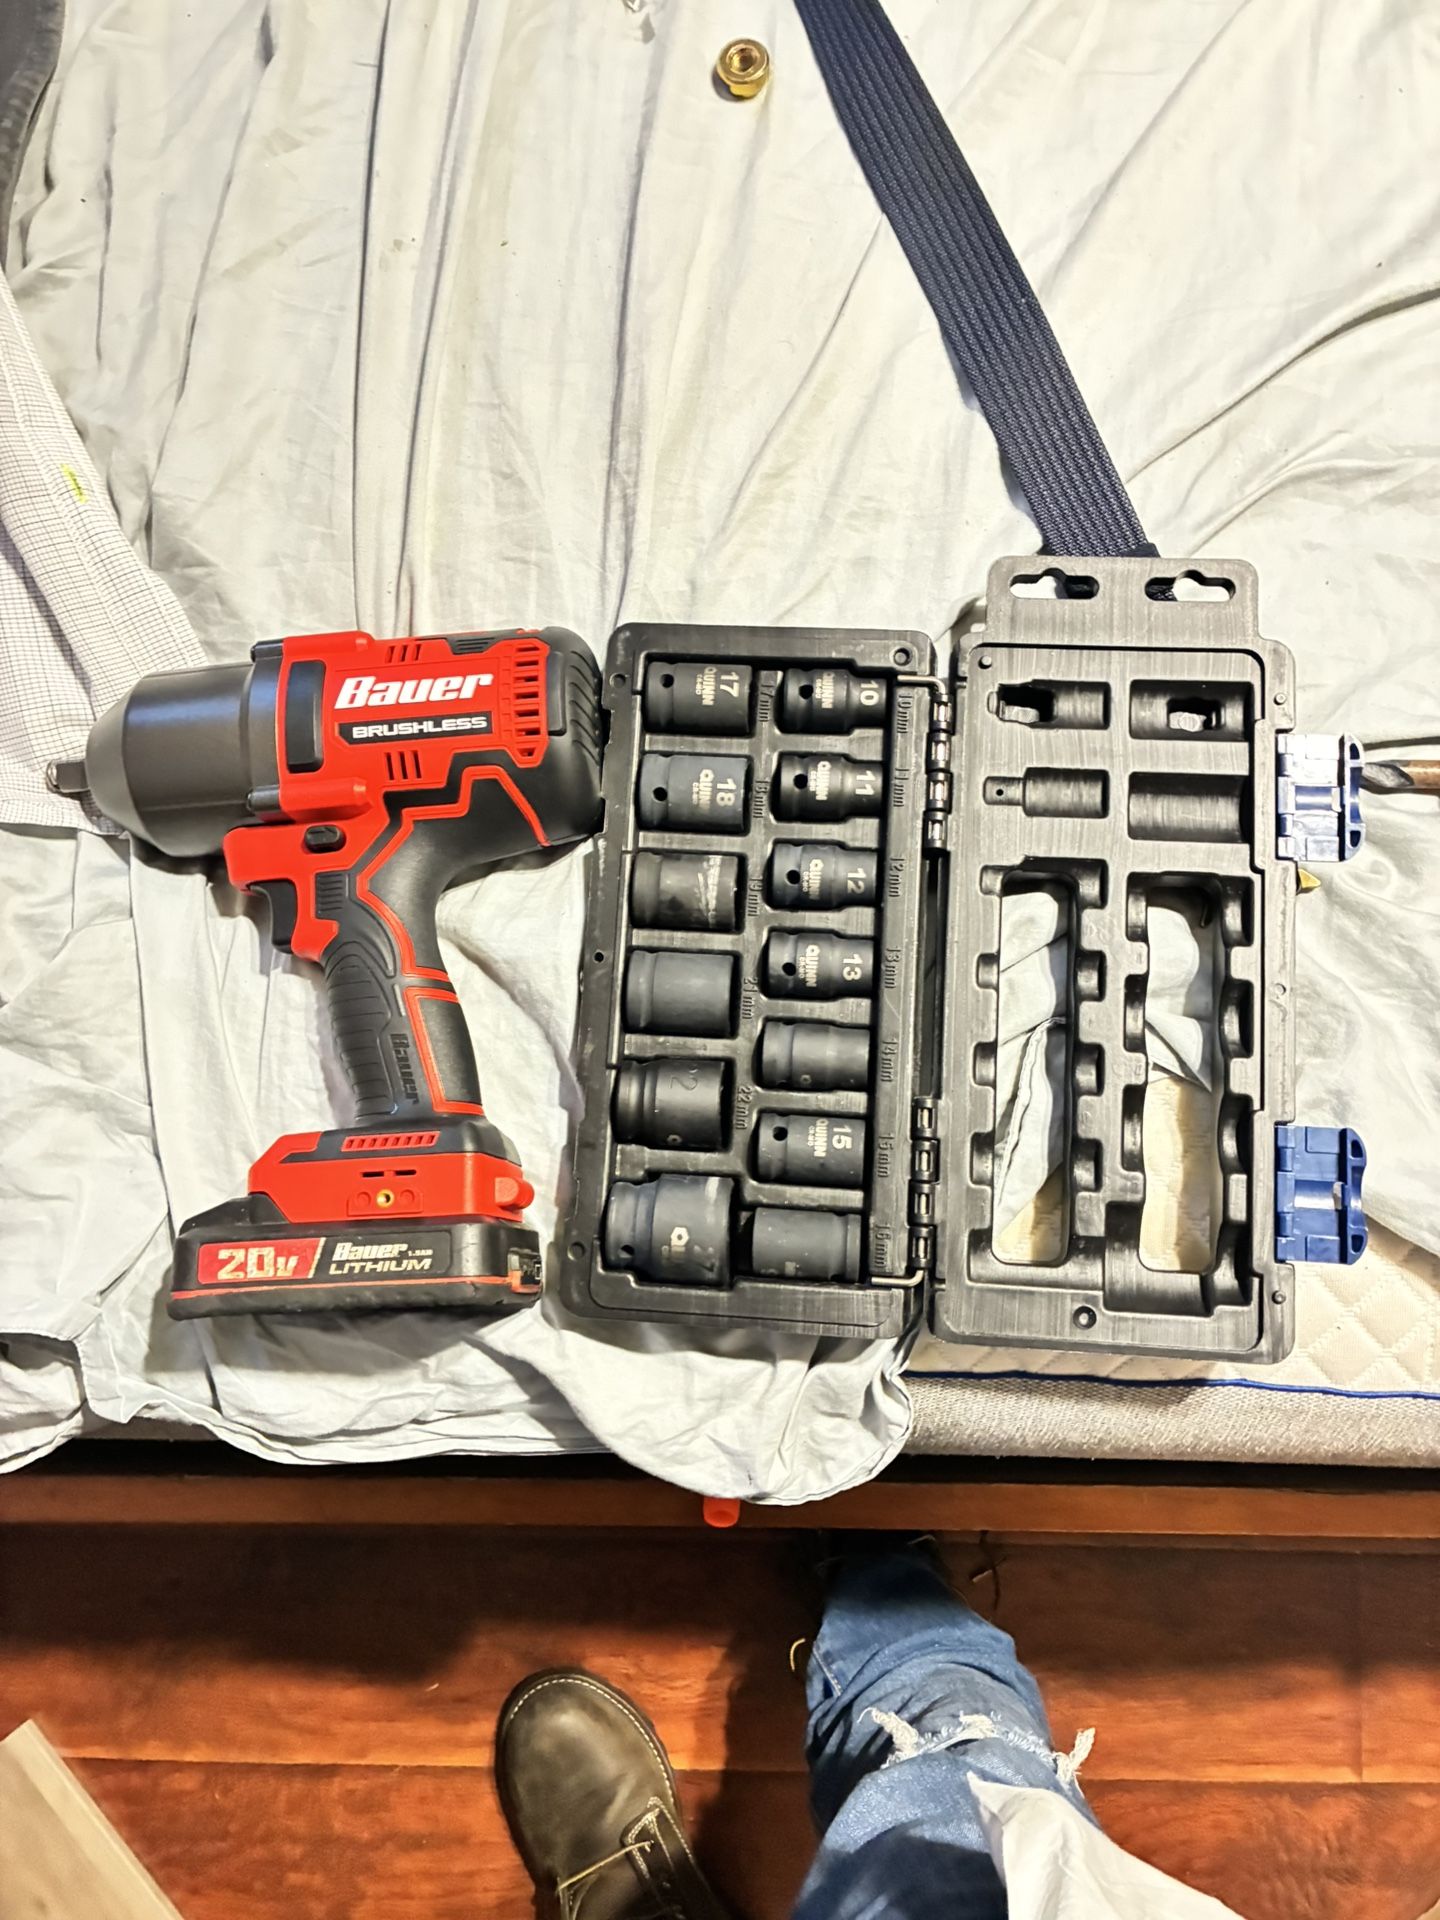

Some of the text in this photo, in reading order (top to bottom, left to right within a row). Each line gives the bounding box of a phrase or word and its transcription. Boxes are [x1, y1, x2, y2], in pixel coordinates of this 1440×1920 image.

[334, 674, 494, 710] Bauer
[702, 666, 716, 706] QUINN
[720, 671, 740, 698] 17
[822, 671, 835, 709] QUINN
[860, 680, 877, 707] 10
[352, 716, 487, 738] BRUSHLESS
[897, 694, 913, 734] 10mm
[716, 777, 736, 807] 18
[816, 761, 831, 801] QUINN
[855, 770, 874, 797] 11
[893, 768, 909, 808] 11mm
[748, 876, 763, 917] 19mm
[809, 859, 822, 900] QUINN
[847, 867, 866, 894] 12
[889, 858, 905, 898] 12mm
[807, 944, 820, 988] QUINN
[843, 953, 863, 981] 13
[884, 946, 901, 988] 13mm
[742, 977, 758, 1020] 21mm
[390, 1033, 419, 1105] Bauer
[881, 1039, 899, 1082] 14mm
[735, 1085, 753, 1130] 22mm
[814, 1118, 828, 1158] QUINN
[832, 1124, 852, 1150] 15
[878, 1134, 894, 1178] 15mm
[333, 1242, 408, 1261] Bauer
[873, 1225, 890, 1267] 16mm
[328, 1259, 431, 1275] LITHIUM
